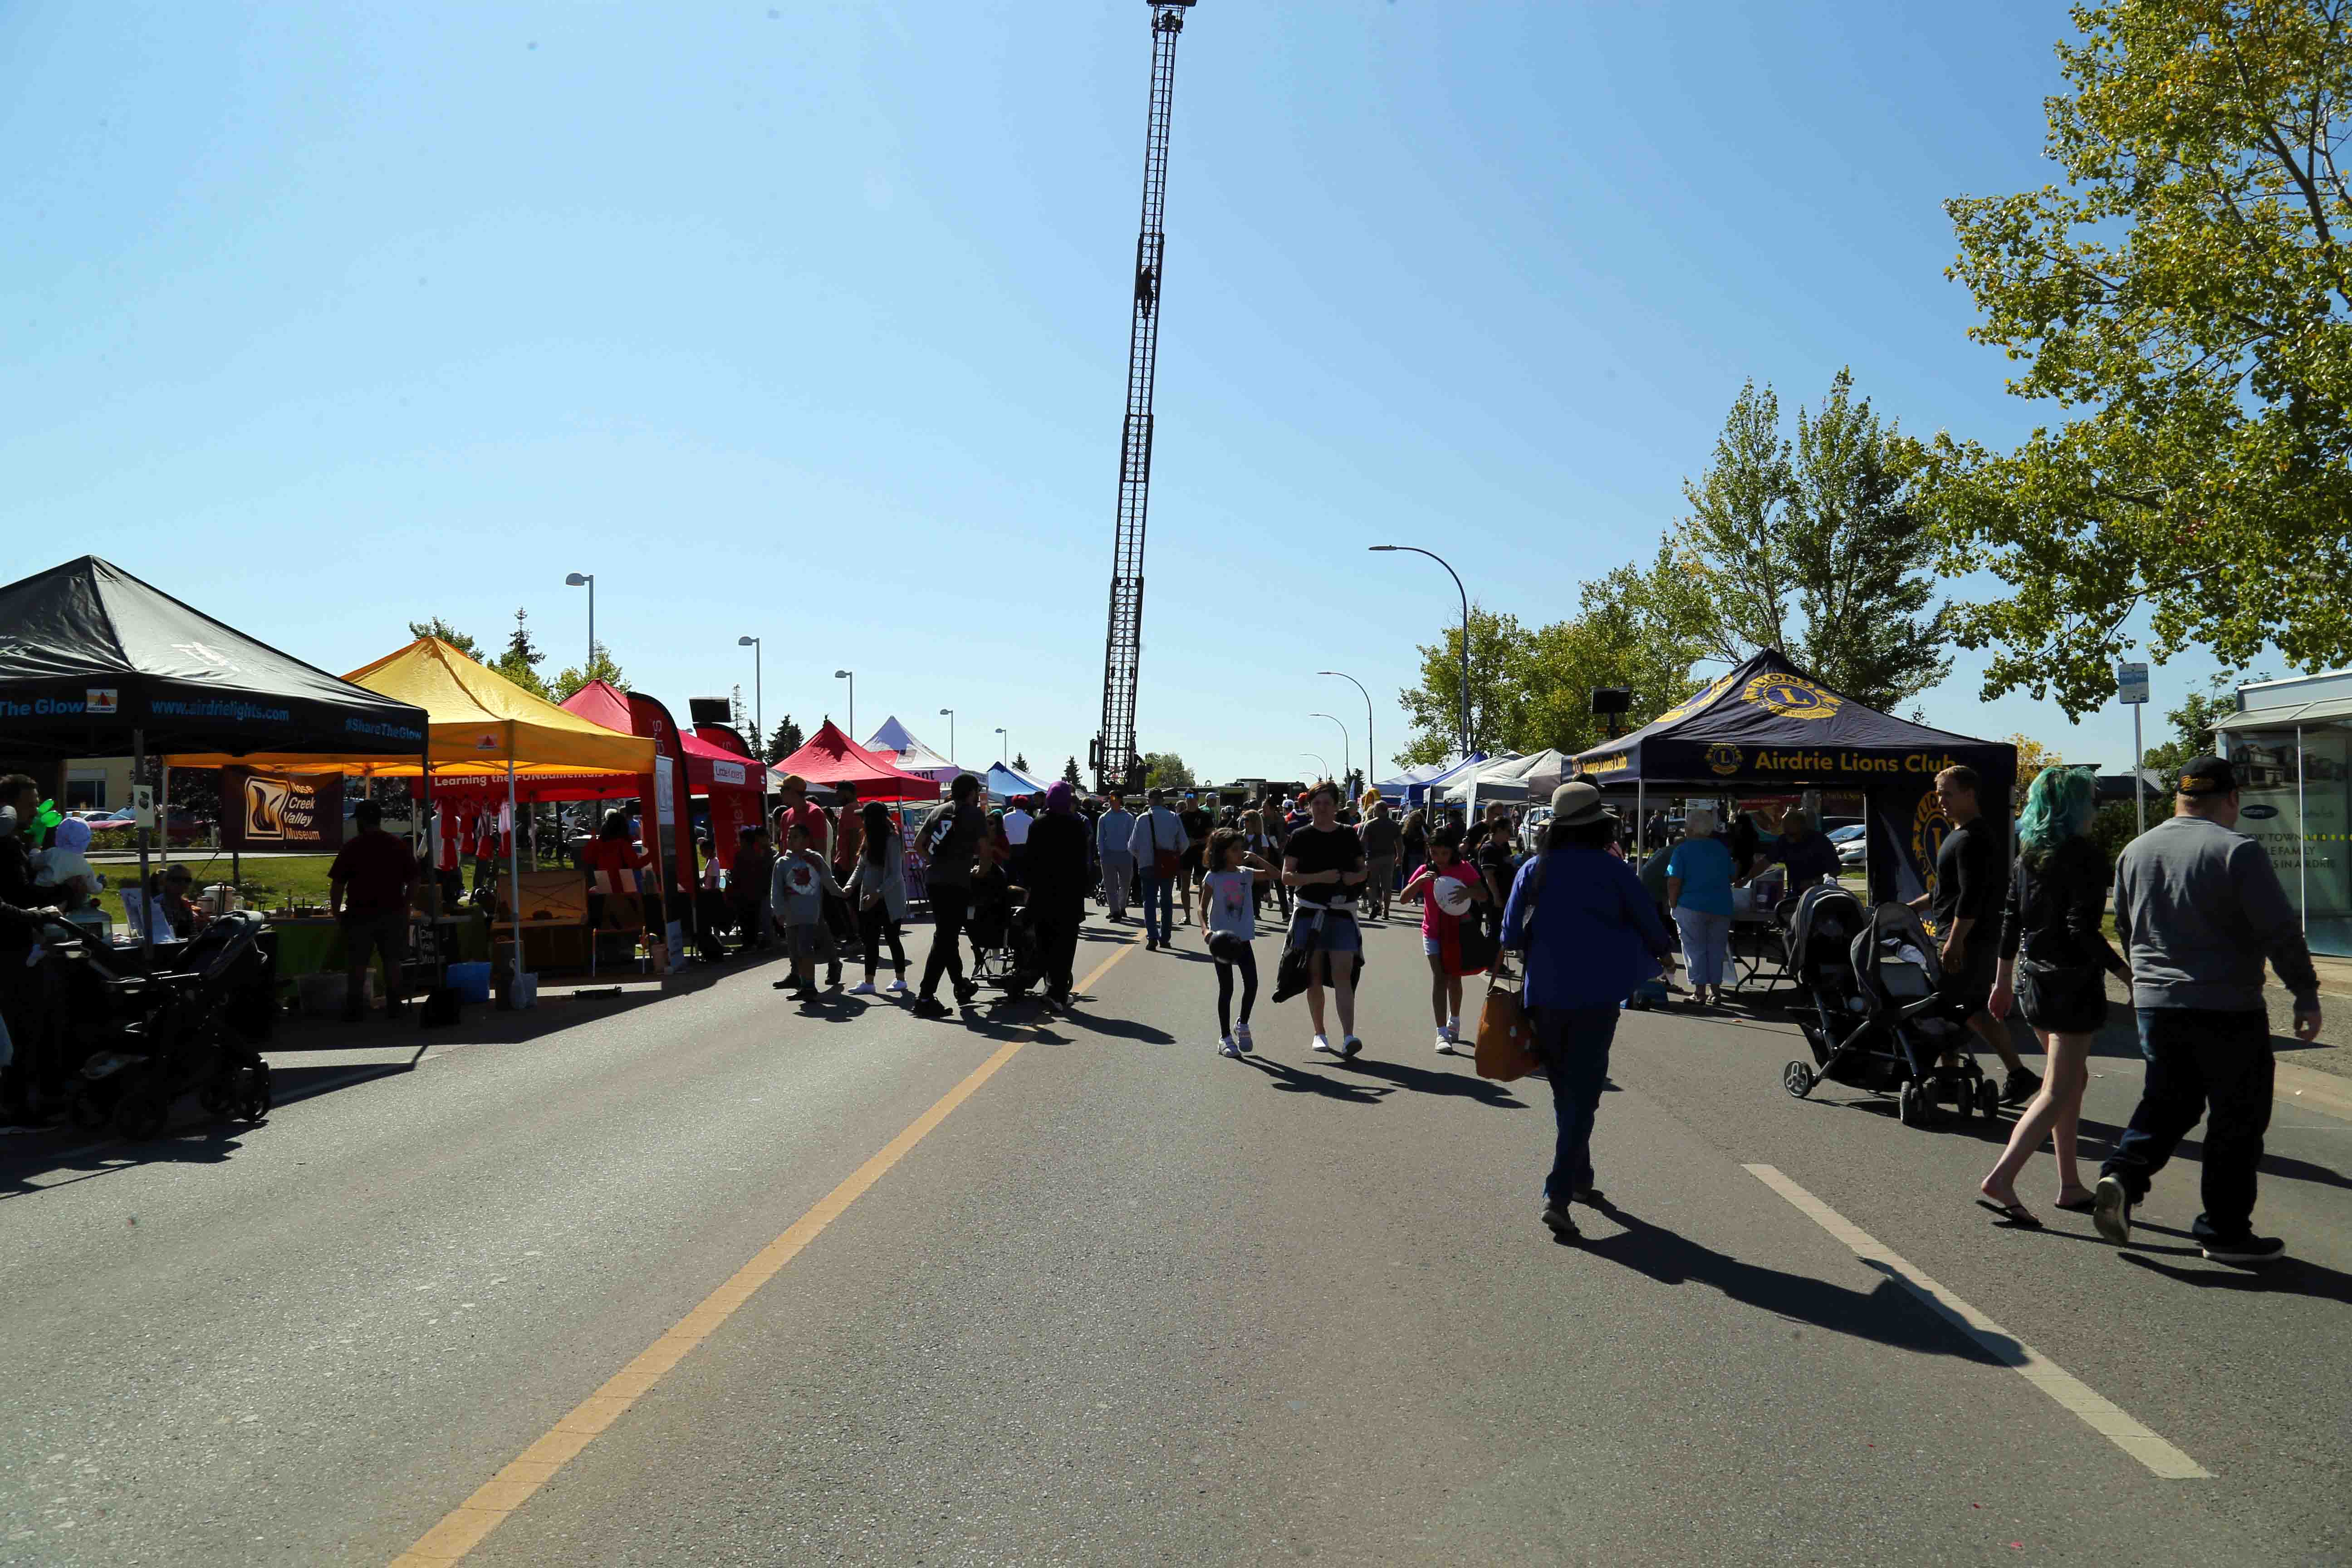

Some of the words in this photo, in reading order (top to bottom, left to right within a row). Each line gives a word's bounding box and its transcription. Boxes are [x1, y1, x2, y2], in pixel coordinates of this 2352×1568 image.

[1749, 673, 1815, 688] LIONS
[0, 700, 31, 715] The
[35, 698, 86, 715] Glow
[152, 699, 290, 722] www.airdrielights.com
[345, 718, 421, 741] #ShareTheGlow
[1614, 751, 1627, 770] Club
[1755, 751, 1833, 771] Airdrie
[1840, 752, 1899, 772] Lions
[1905, 752, 1956, 773] Club
[290, 781, 314, 794] Nose
[435, 775, 487, 787] Learning
[491, 774, 509, 783] the
[289, 797, 315, 809] Creek
[283, 811, 313, 828] Valley
[286, 827, 320, 841] Museum
[2268, 833, 2301, 842] TOWN
[2279, 847, 2315, 855] FAMLY
[2294, 860, 2336, 868] ARDRIE
